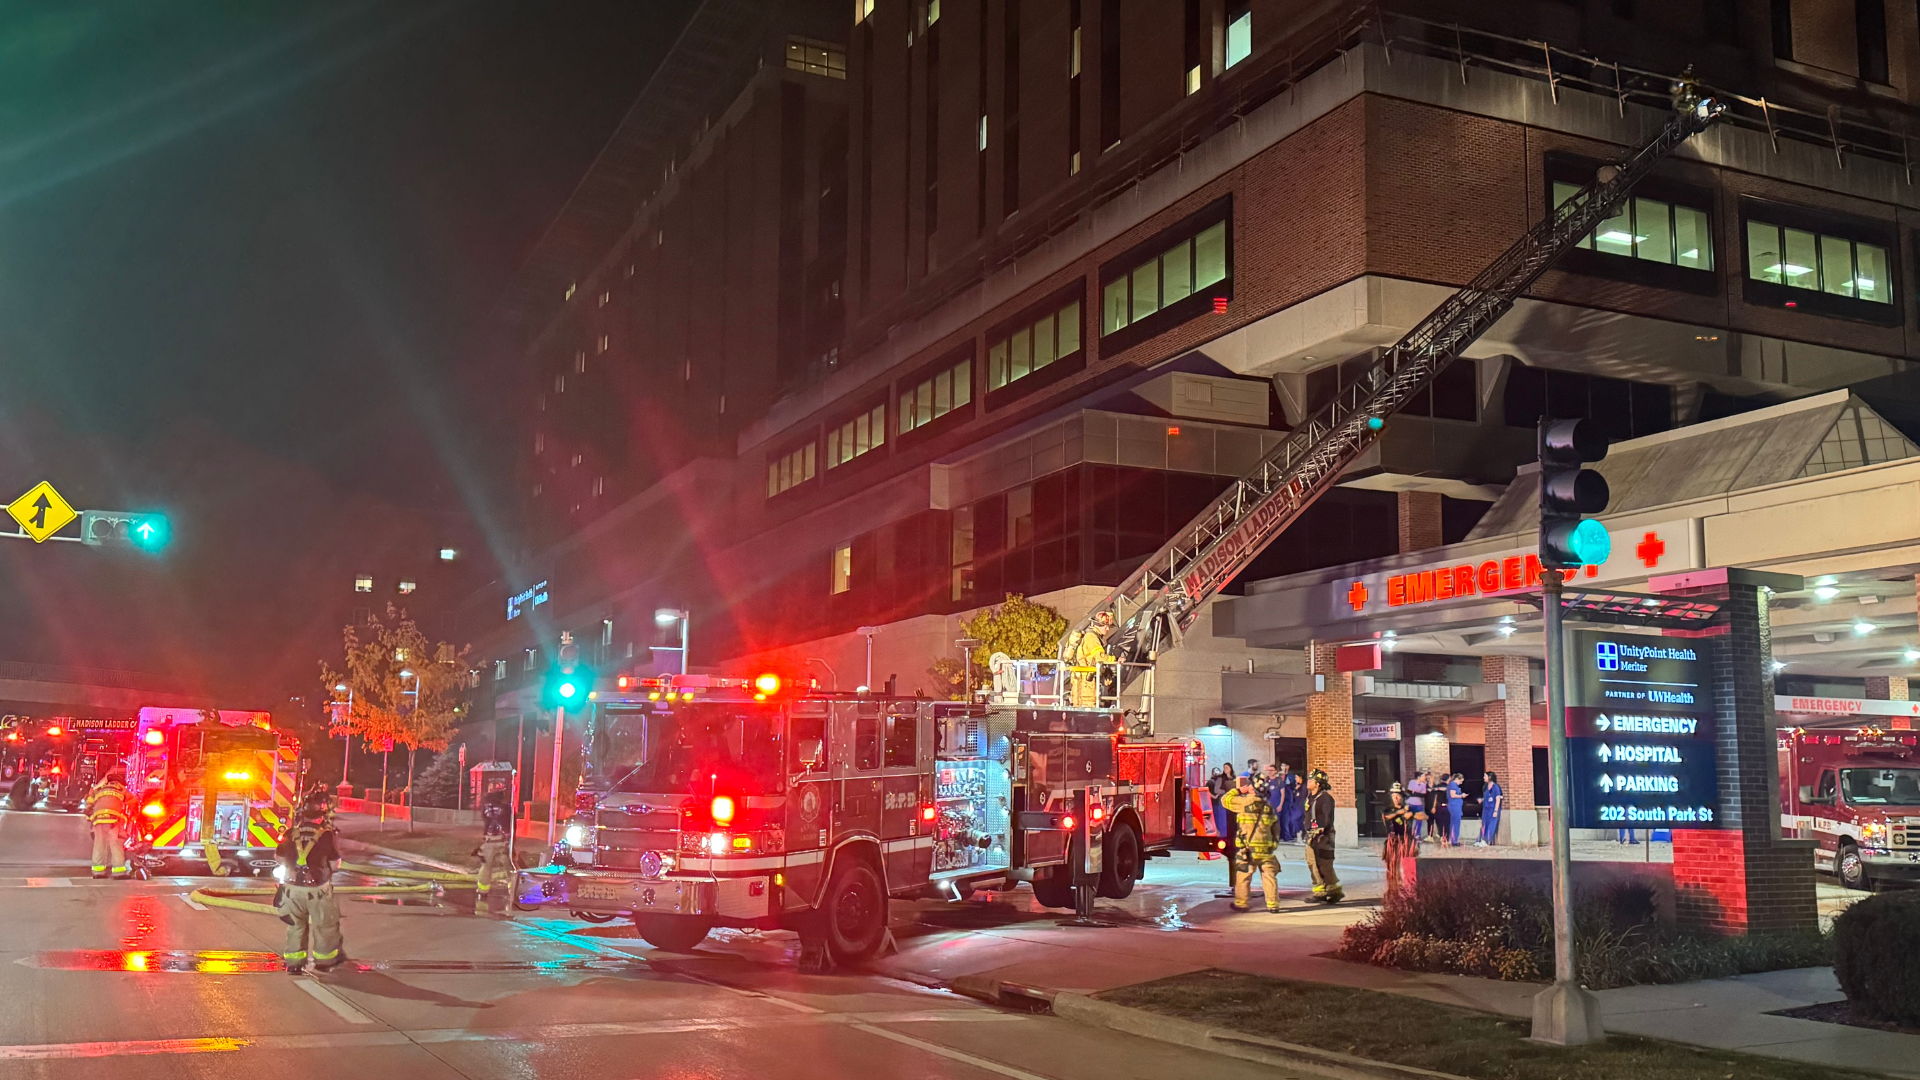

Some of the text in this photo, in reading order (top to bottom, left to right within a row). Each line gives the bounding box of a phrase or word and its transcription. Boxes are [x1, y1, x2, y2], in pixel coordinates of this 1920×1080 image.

[1184, 532, 1244, 594] MADISON
[1243, 487, 1292, 541] LADDER
[1619, 645, 1697, 661] UnityPoint Health
[1620, 661, 1648, 672] Meriter
[1605, 690, 1635, 699] PARTNER
[1648, 690, 1694, 704] UWHealth
[1792, 698, 1862, 712] EMERGENCY
[76, 719, 103, 728] MADISON
[105, 720, 129, 729] LADDER
[1361, 725, 1394, 733] AMBULANCE
[1613, 715, 1698, 734] EMERGENCY
[1615, 745, 1682, 763] HOSPITAL
[1616, 775, 1679, 793] PARKING
[1600, 806, 1713, 822] 202 South Park St
